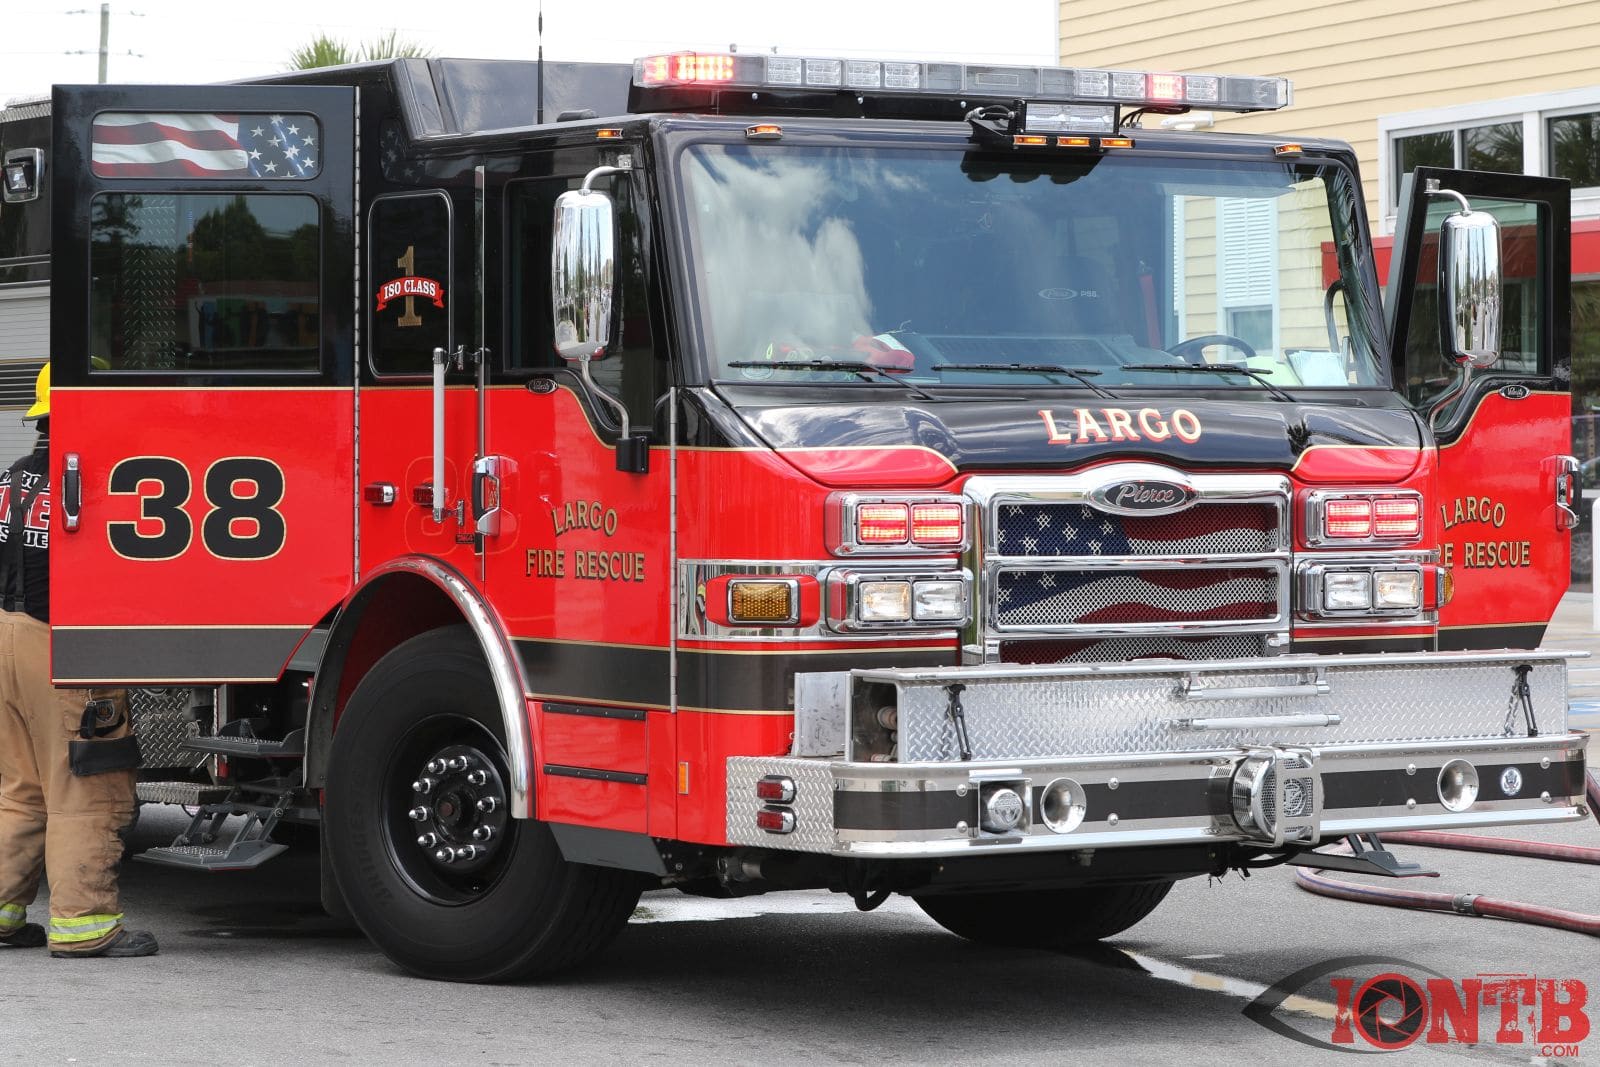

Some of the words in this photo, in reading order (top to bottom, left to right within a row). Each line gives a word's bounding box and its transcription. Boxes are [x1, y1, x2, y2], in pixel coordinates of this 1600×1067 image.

[384, 281, 401, 300] ISO
[404, 279, 436, 297] CLASS
[1038, 407, 1202, 445] LARGO
[107, 455, 287, 561] 38
[1115, 483, 1176, 507] Pierce
[551, 500, 618, 537] LARGO
[1441, 496, 1506, 531] LARGO
[526, 549, 566, 580] FIRE
[575, 550, 645, 583] RESCUE
[1464, 541, 1531, 569] RESCUE
